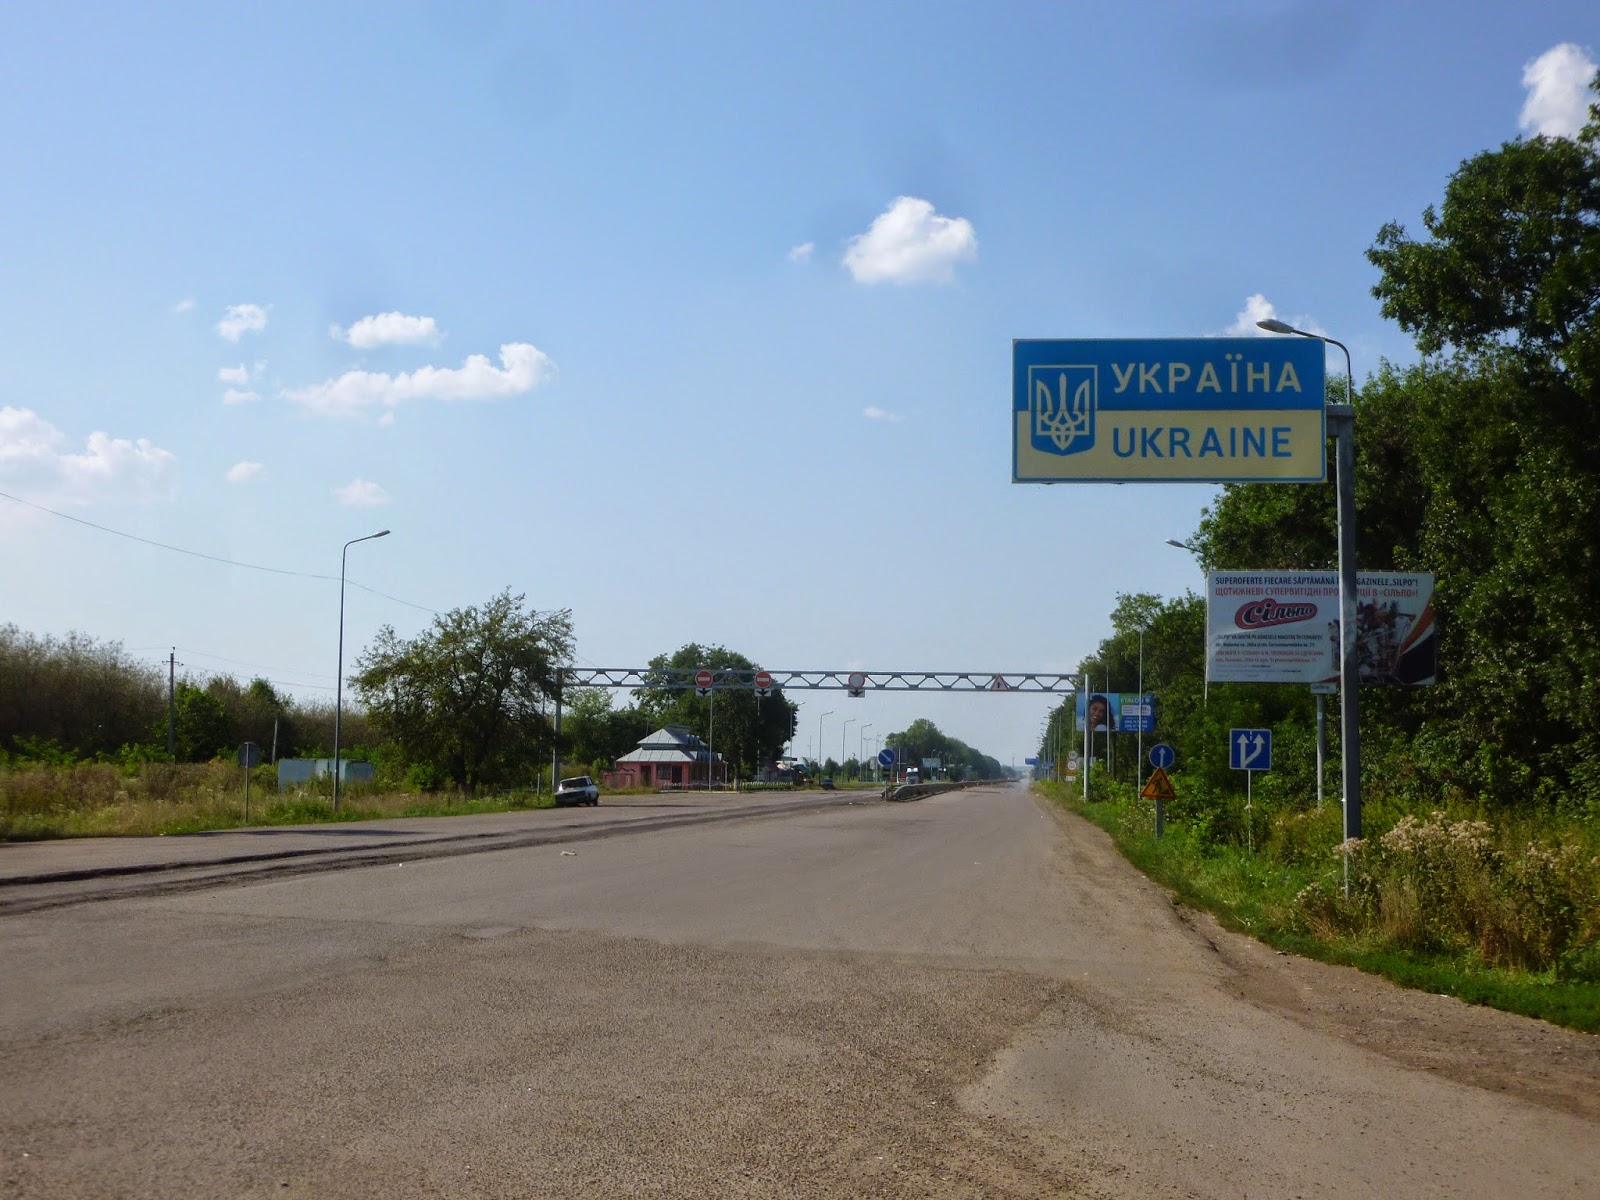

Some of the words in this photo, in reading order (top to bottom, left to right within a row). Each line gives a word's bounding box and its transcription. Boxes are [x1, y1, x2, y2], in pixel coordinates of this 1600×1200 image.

[1110, 353, 1302, 394] УКРАЇНА
[1112, 426, 1293, 459] UKRAINE
[1215, 576, 1262, 585] SUPEROFERTE
[1264, 576, 1292, 585] FIECARE
[1356, 577, 1388, 587] GAZINELE
[1215, 587, 1264, 597] ЩОТИЖНЕВІ
[1242, 601, 1313, 625] Сільпо
